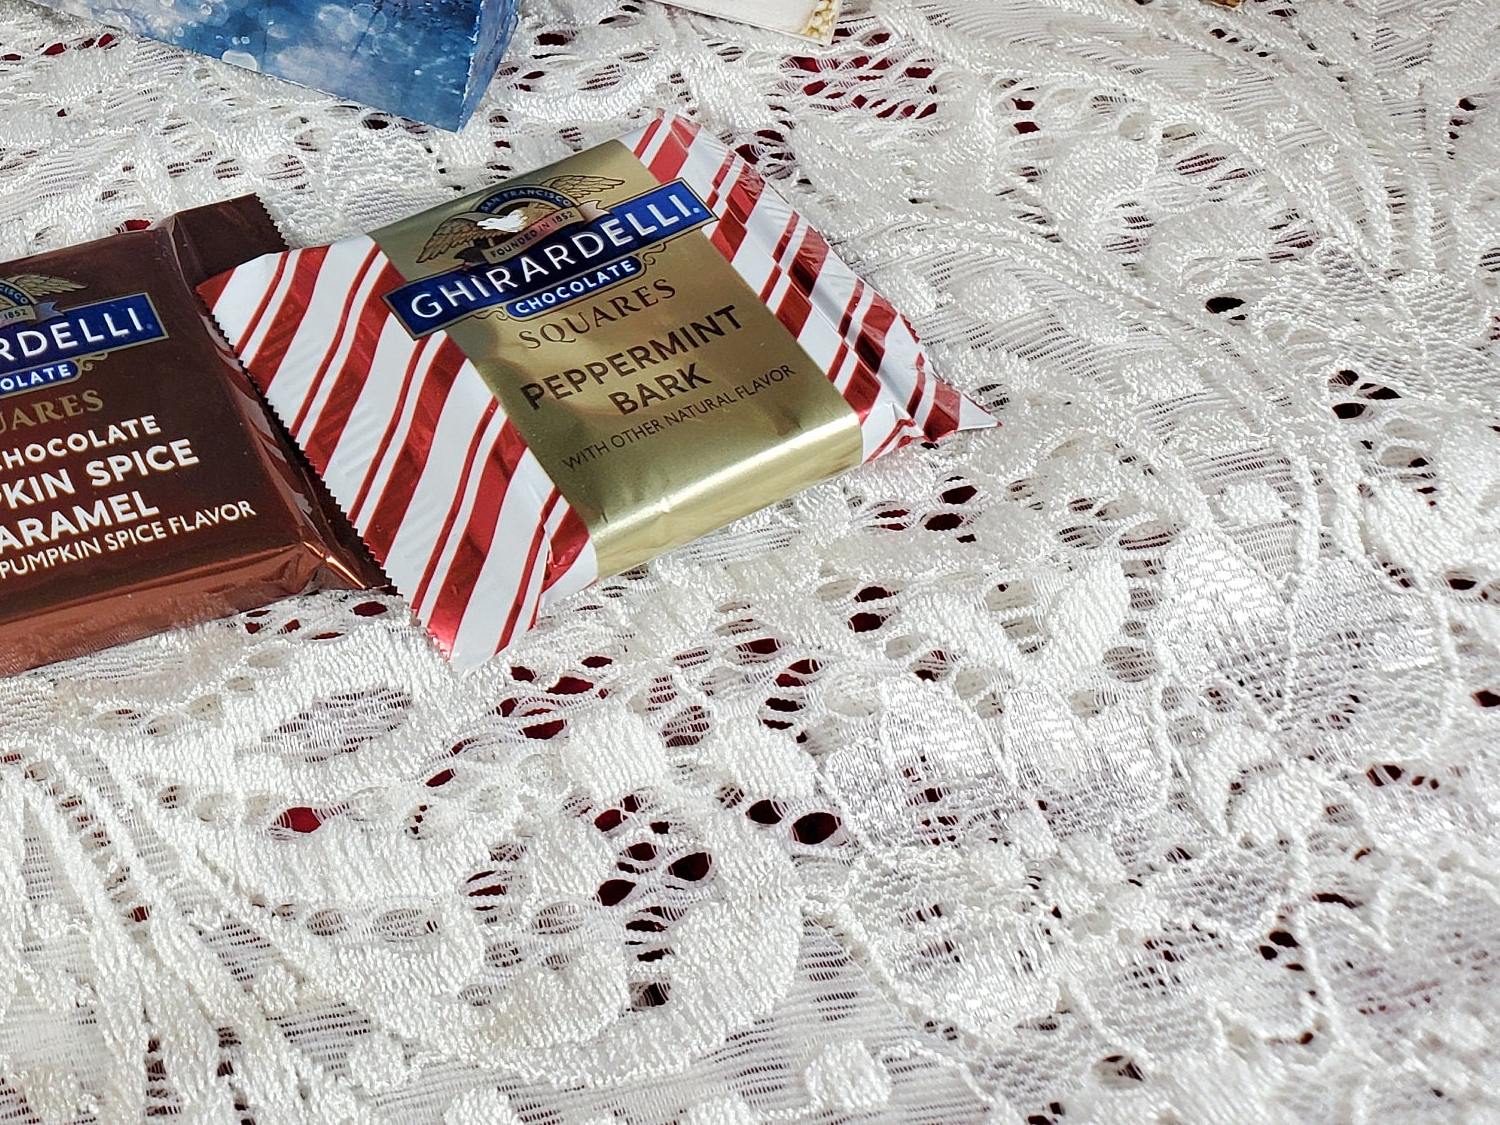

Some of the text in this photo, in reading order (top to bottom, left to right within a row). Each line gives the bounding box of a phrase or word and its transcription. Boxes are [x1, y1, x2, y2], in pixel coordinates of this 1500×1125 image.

[481, 188, 571, 211] SAN FRANCISCO
[410, 193, 691, 320] GHIRARDELLI
[490, 229, 538, 258] FOUNDED
[552, 211, 574, 224] 1852
[4, 308, 28, 320] 1852
[514, 258, 637, 315] CHOCOLATE
[519, 278, 677, 350] SQUARES
[520, 304, 745, 411] PEPPERMINT
[607, 361, 713, 417] BARK
[562, 363, 796, 472] WITH OTHER NATURAL FLAVOR
[86, 438, 200, 488] SPICE
[106, 521, 168, 552] SPICE
[169, 500, 257, 536] FLAVOR
